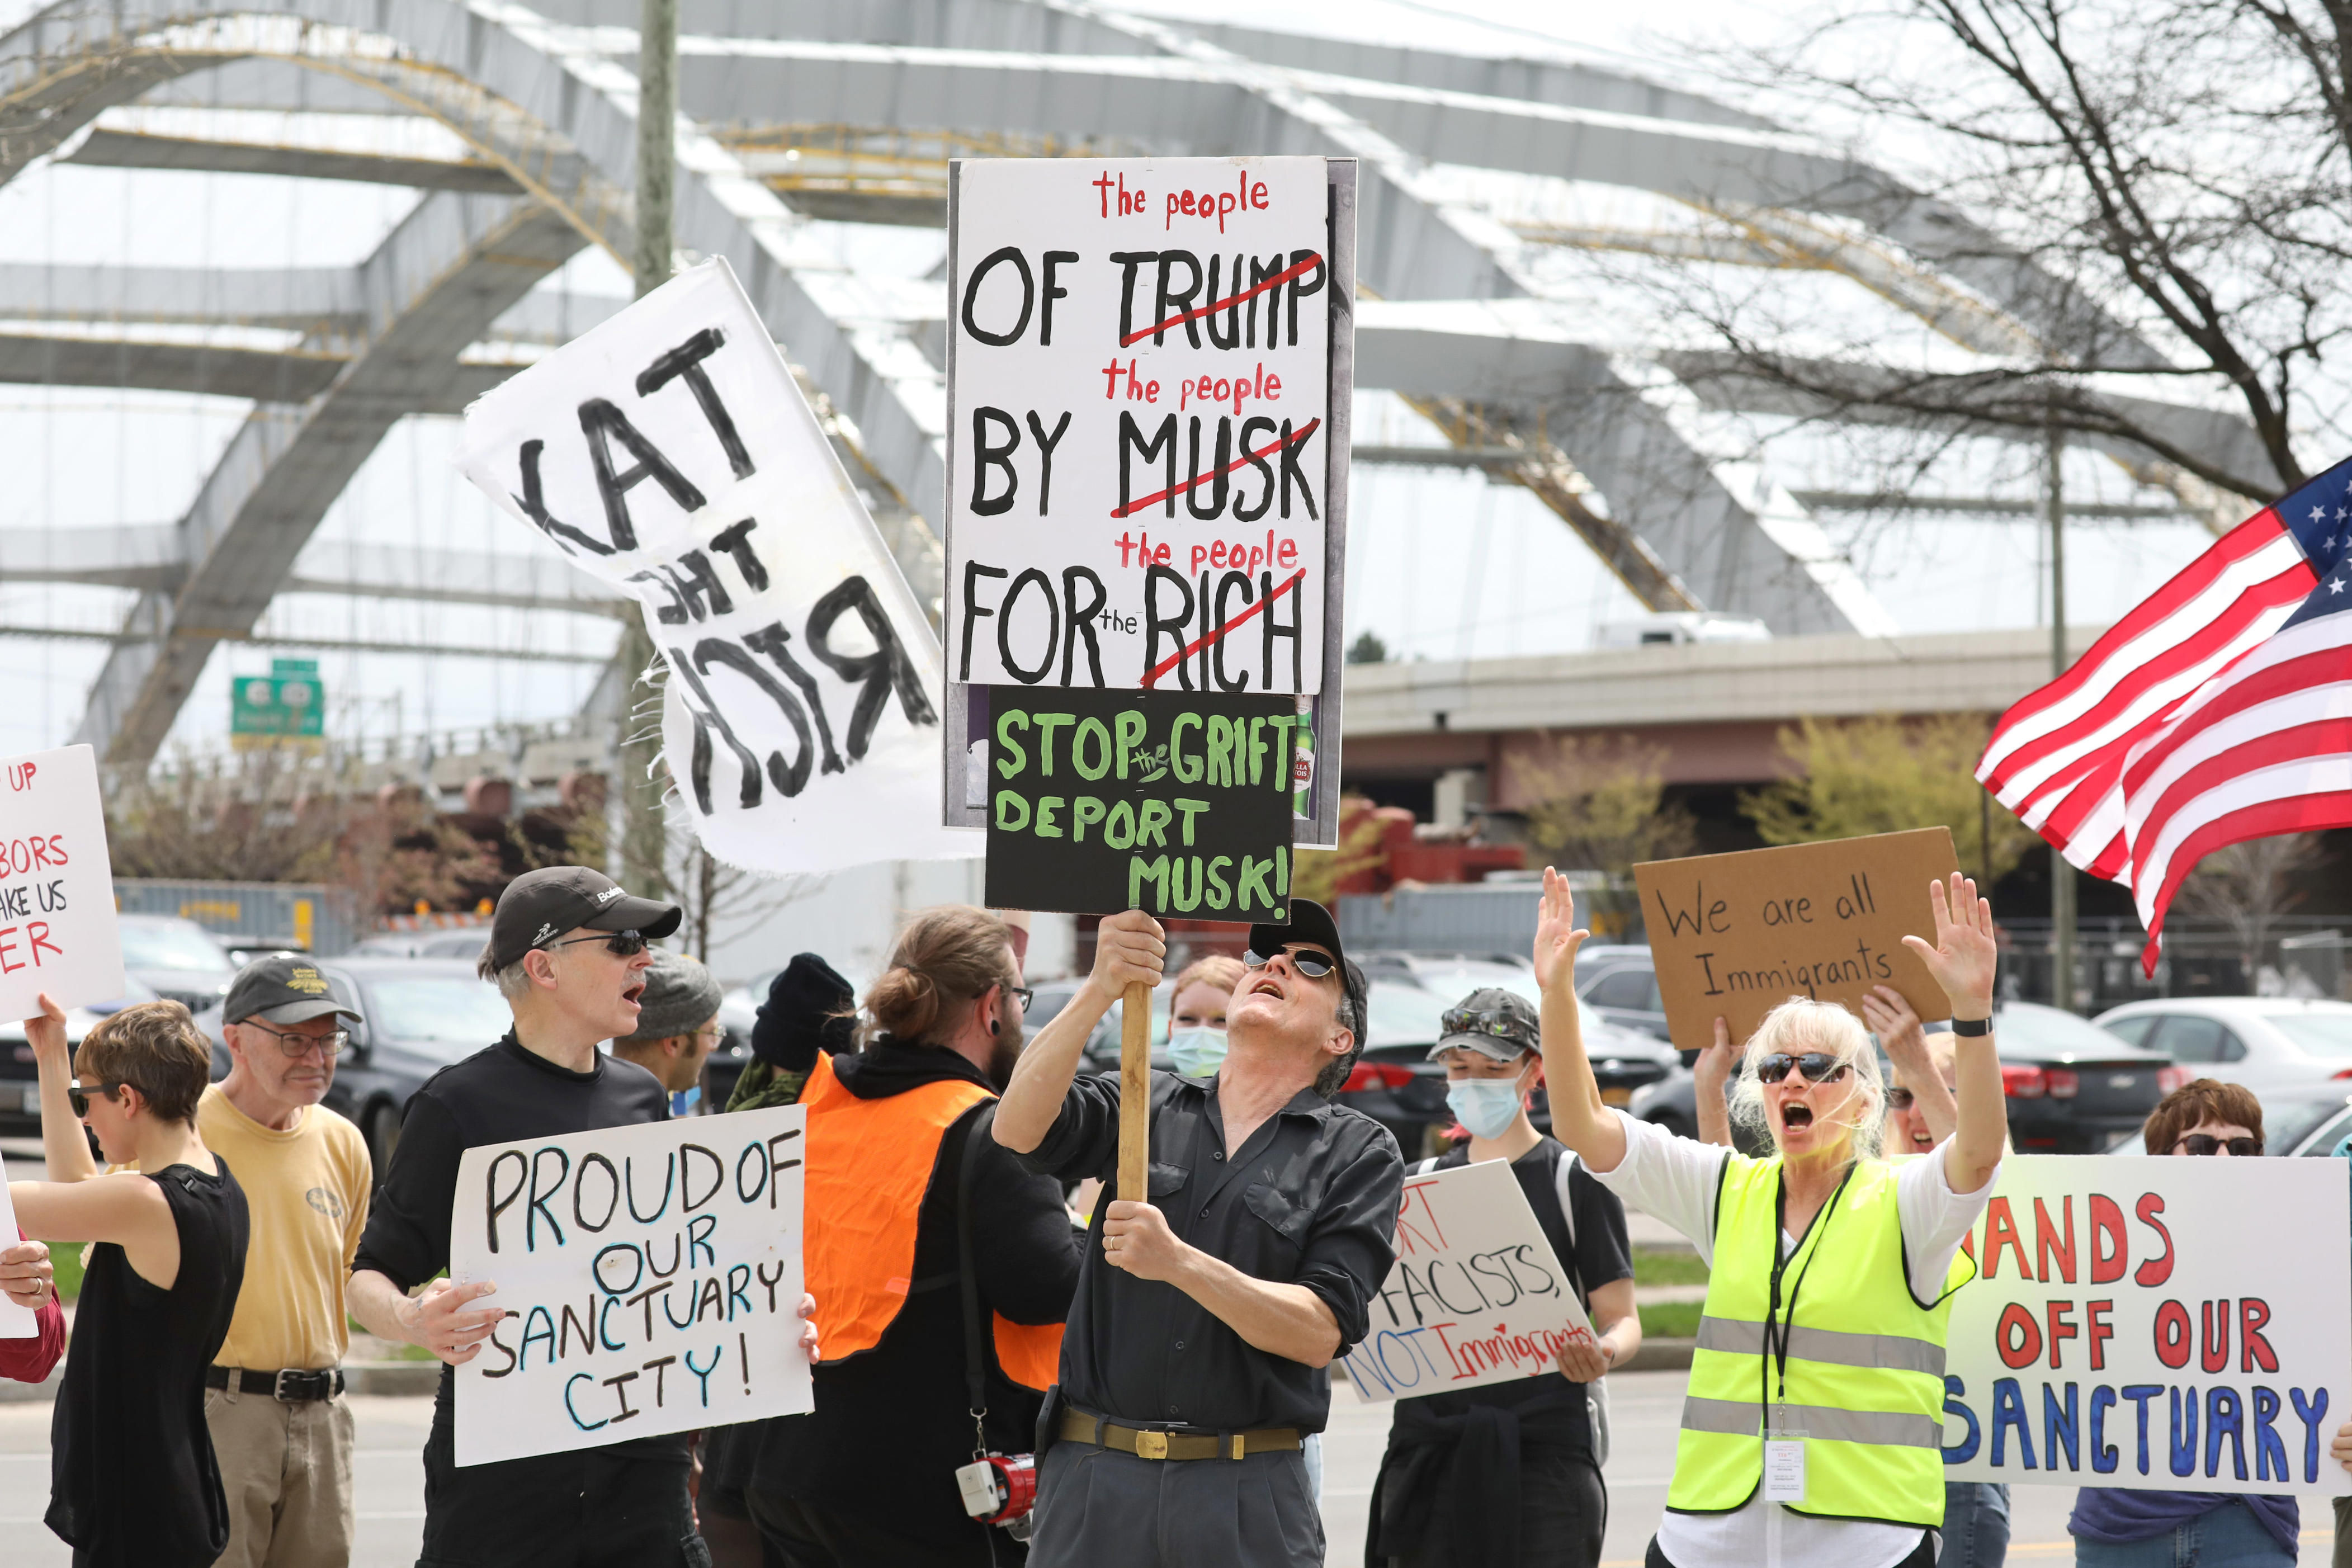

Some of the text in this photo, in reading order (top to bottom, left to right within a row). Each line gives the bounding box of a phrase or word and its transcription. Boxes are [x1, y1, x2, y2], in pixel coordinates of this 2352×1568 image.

[1093, 171, 1269, 233] the people
[962, 247, 1326, 350] OF TRUMP
[1102, 358, 1282, 415] the people
[970, 407, 1320, 521] BY MUSK
[1115, 530, 1298, 578] the people
[960, 560, 1304, 693] FOR the RICH
[8, 762, 36, 791] UP
[996, 709, 1296, 792] STOP the GRIFT
[995, 790, 1210, 849] DEPORT
[36, 880, 67, 913] US
[1128, 846, 1287, 919] MUSK!
[1656, 872, 1876, 937] We are all
[1695, 938, 1892, 1000] Immigrants
[487, 1128, 801, 1253] PROUD OF
[592, 1213, 716, 1295] OUR
[1961, 1192, 2175, 1287] ANDS
[482, 1260, 784, 1377] SANCTUARY
[1996, 1297, 2279, 1373] OFF OUR
[564, 1333, 751, 1431] CITY!
[1343, 1328, 1437, 1397] NOT
[1943, 1375, 2329, 1483] SANCTUARY
